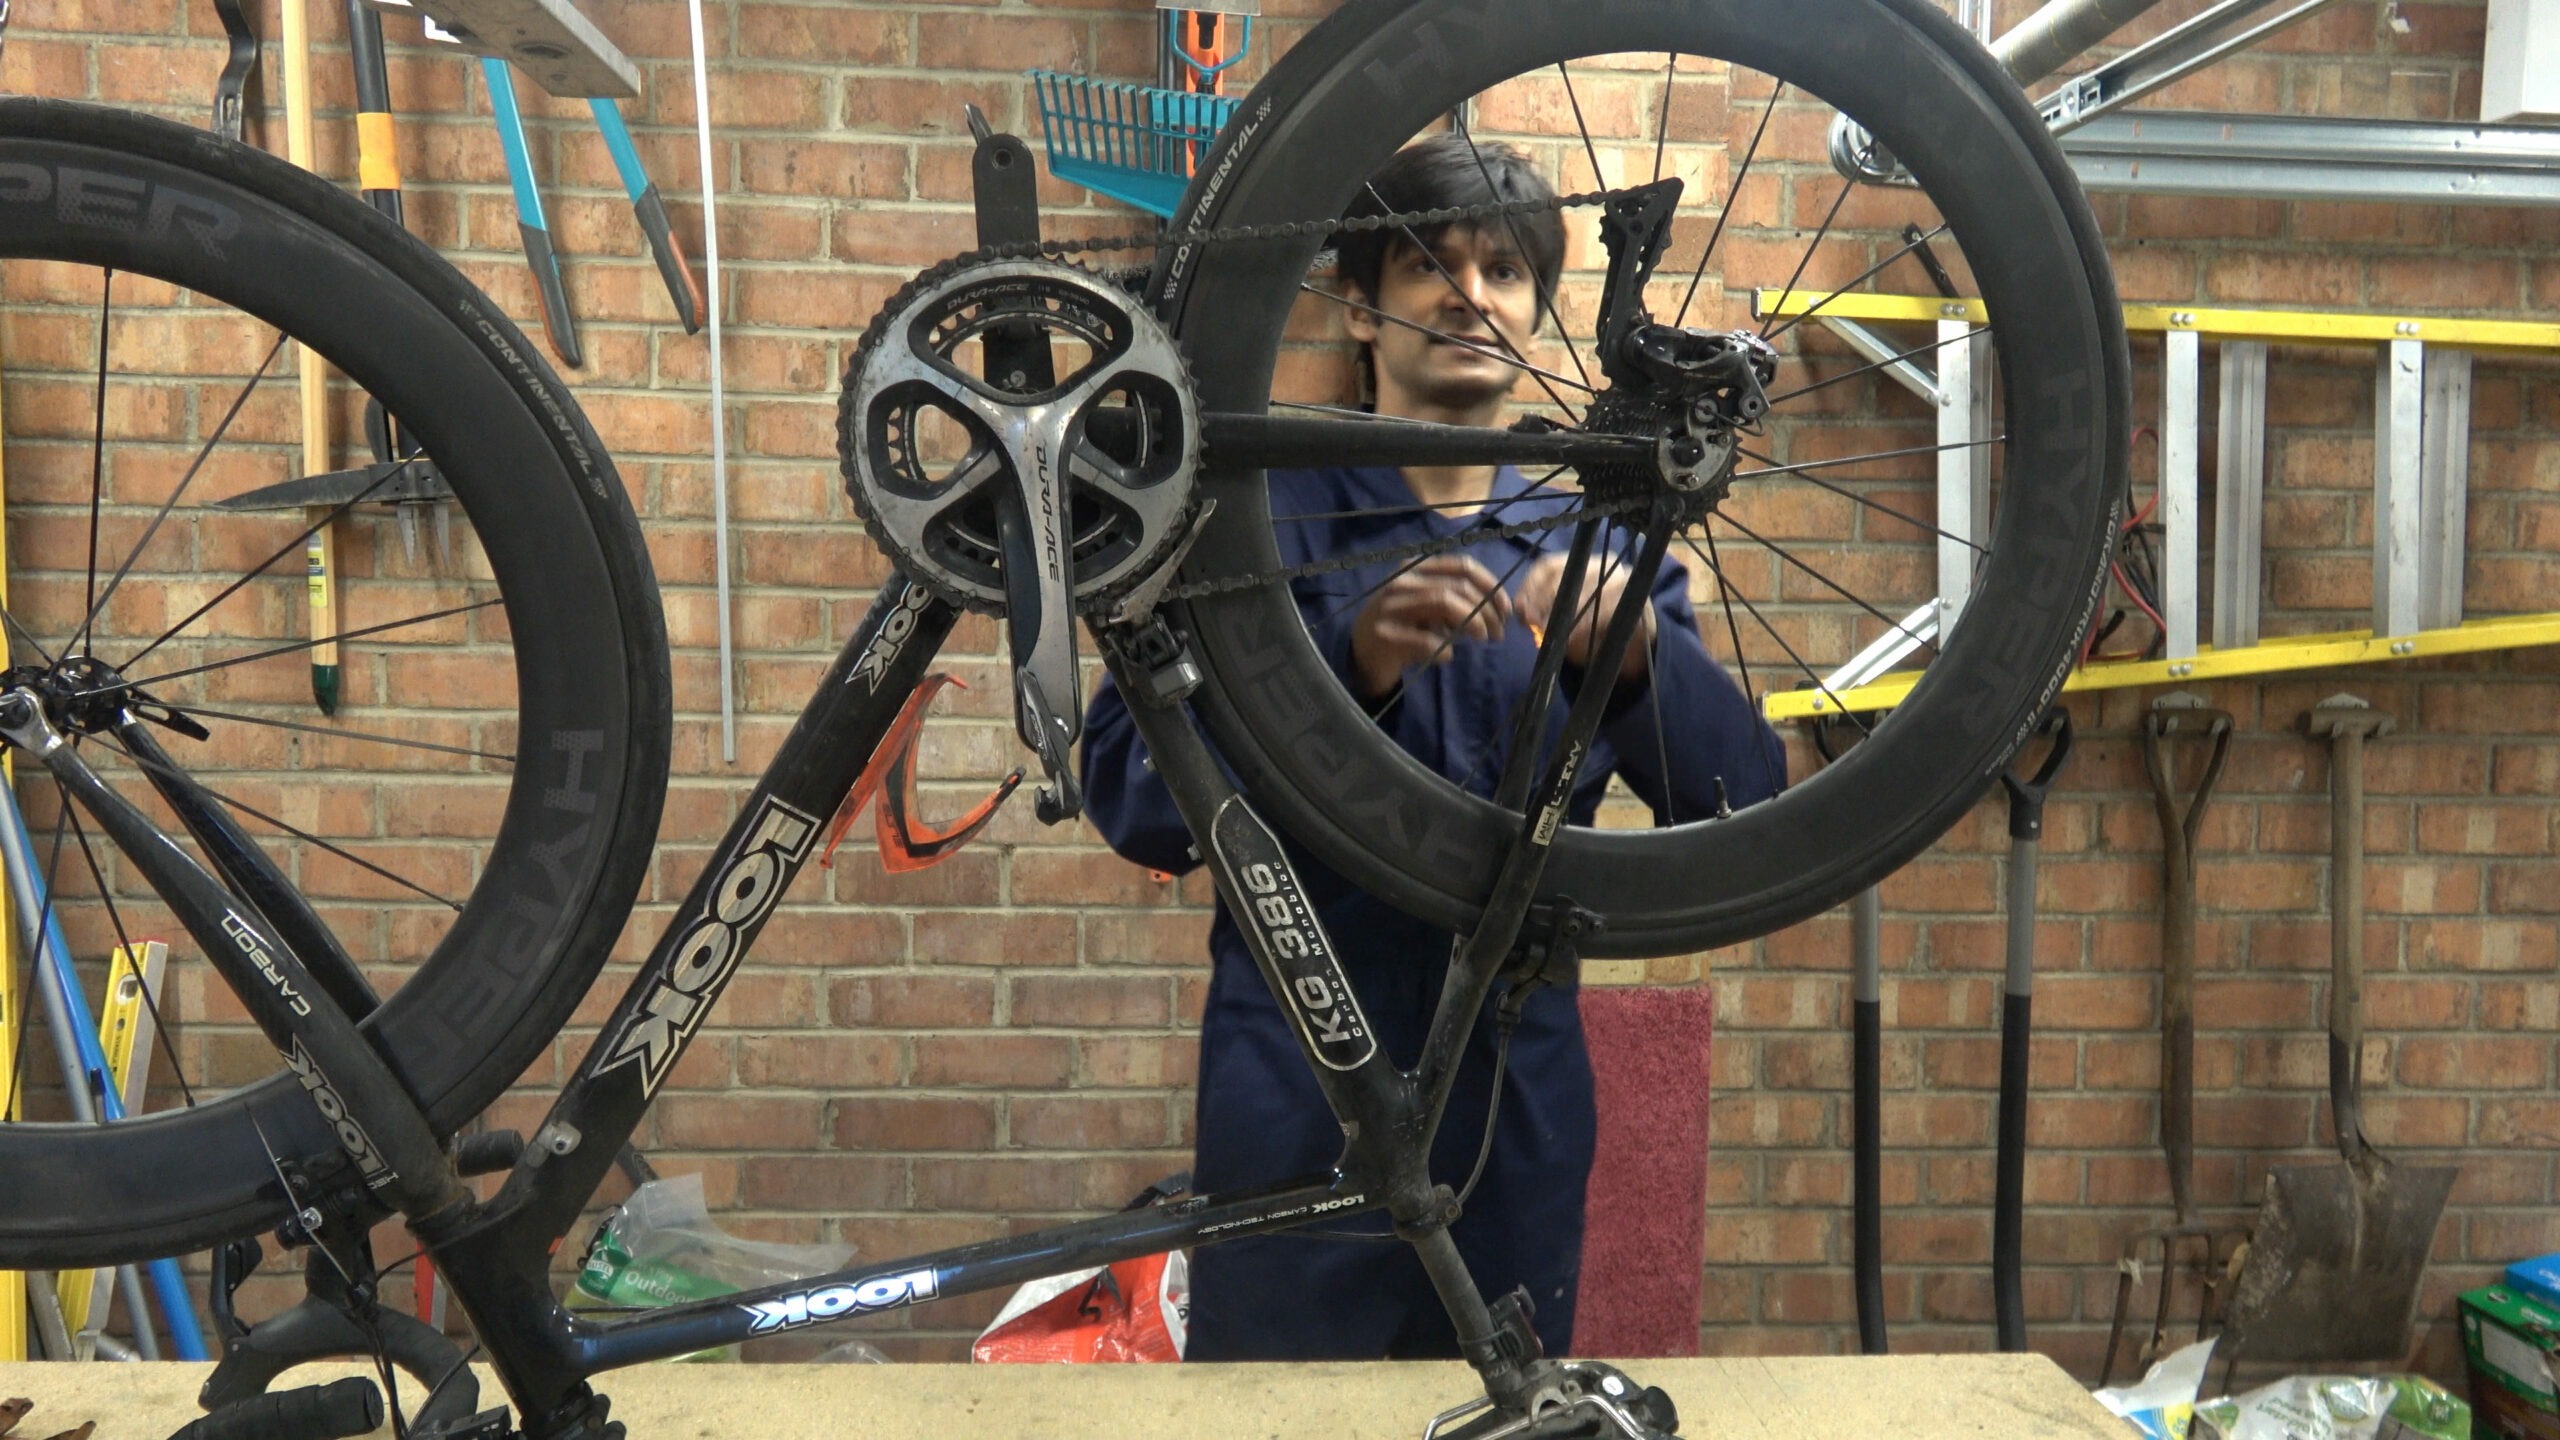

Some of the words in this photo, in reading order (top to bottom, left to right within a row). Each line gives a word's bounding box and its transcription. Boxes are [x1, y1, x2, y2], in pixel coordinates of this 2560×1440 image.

[946, 282, 1029, 310] DURA-ACE
[477, 320, 593, 475] CONTINENTAL
[1035, 445, 1060, 583] DURA-ACE
[1961, 371, 2091, 738] HYPER
[844, 580, 934, 697] OOK
[1217, 603, 1478, 880] HYPER
[589, 794, 822, 1100] LOOK
[1240, 864, 1310, 960] 386
[220, 915, 312, 1017] CARBON
[1299, 976, 1353, 1044] KG
[1327, 968, 1363, 1038] Carbon
[280, 1032, 388, 1177] LOOK
[1197, 1217, 1264, 1235] TECHNOLOGY
[1267, 1206, 1307, 1220] CARBON
[1311, 1194, 1365, 1214] LOOK
[737, 1265, 940, 1335] LOOK
